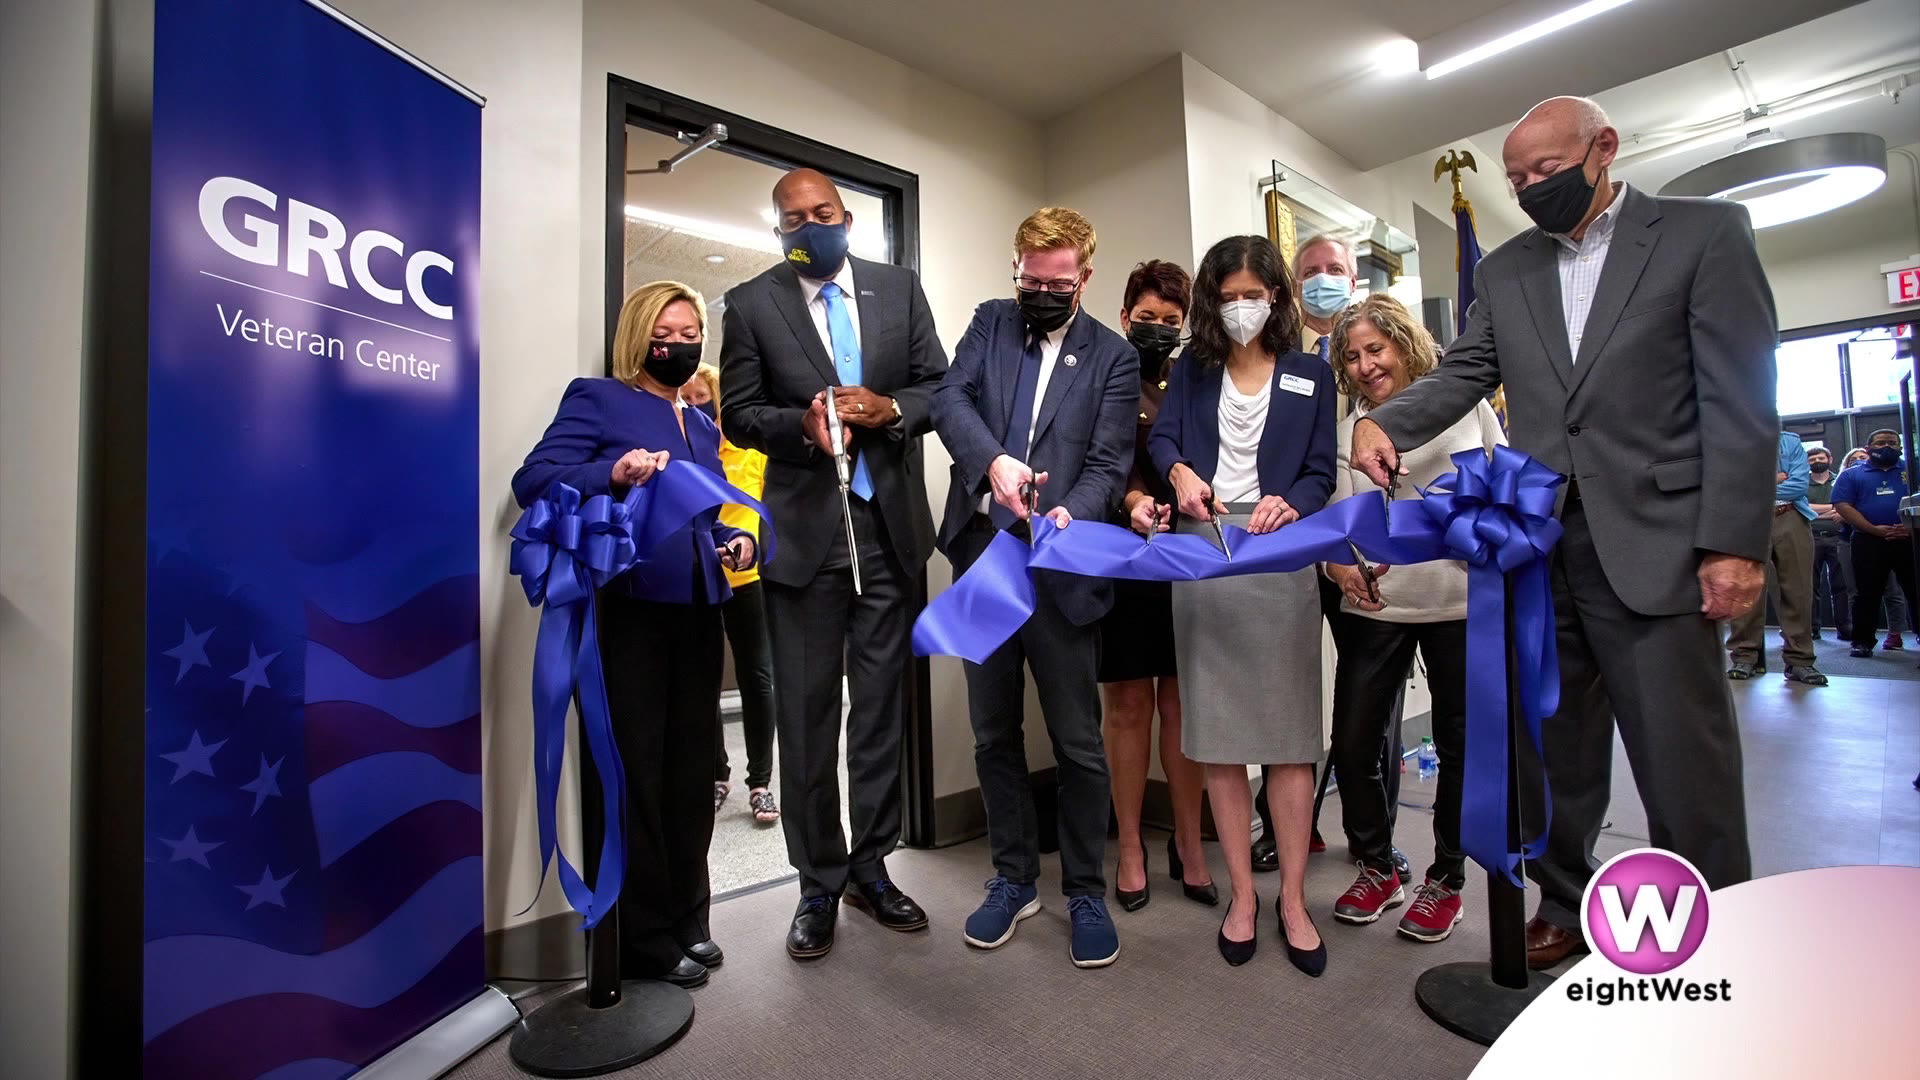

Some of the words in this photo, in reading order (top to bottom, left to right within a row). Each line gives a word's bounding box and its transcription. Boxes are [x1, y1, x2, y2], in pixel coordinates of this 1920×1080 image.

[198, 176, 454, 320] GRCC
[216, 303, 344, 361] Veteran
[356, 340, 440, 382] Center
